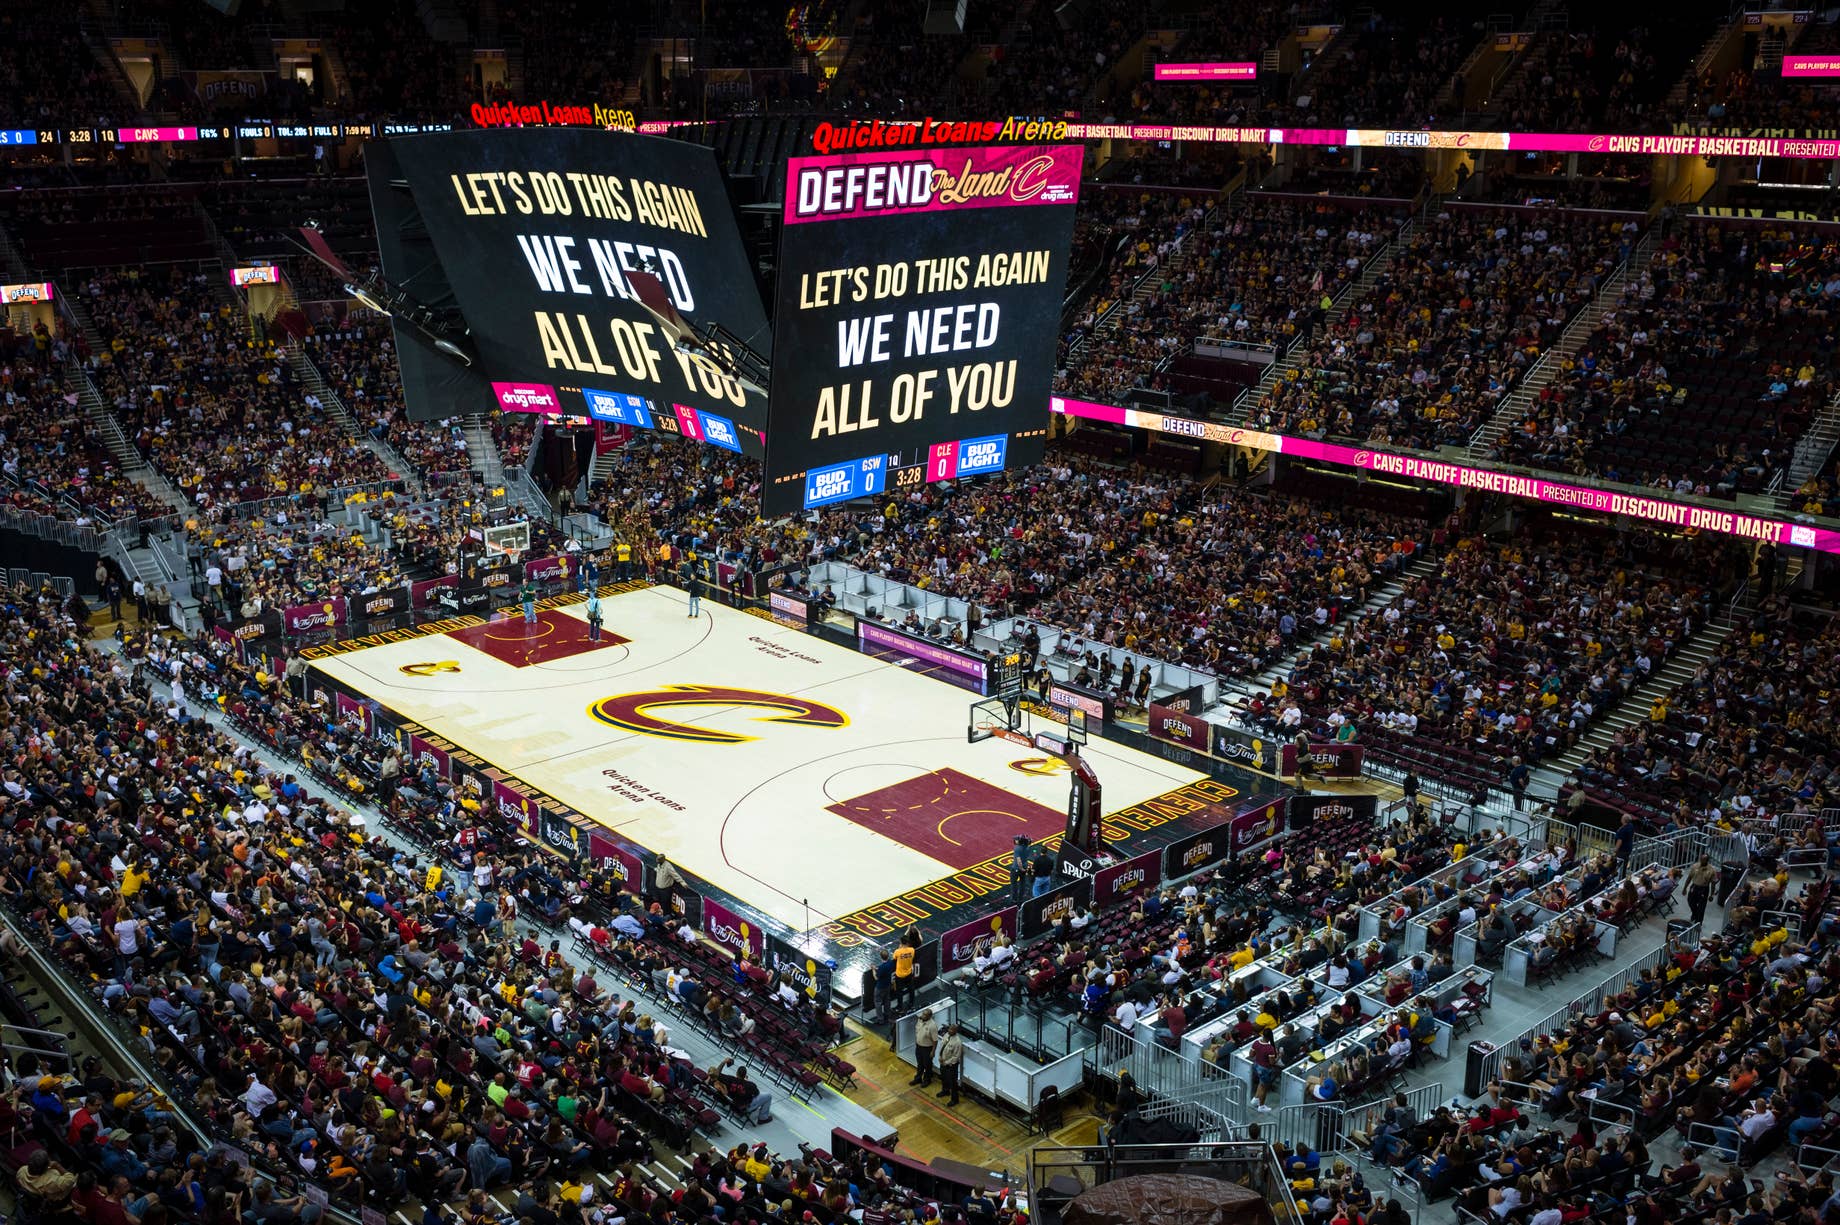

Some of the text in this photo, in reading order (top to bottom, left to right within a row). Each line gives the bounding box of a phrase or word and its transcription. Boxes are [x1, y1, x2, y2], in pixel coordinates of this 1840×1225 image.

[206, 81, 257, 100] DEFEND
[470, 101, 636, 129] Quicken Loans Arena
[16, 132, 22, 143] 0
[41, 132, 53, 143] 24
[70, 131, 91, 142] 3:28
[101, 130, 114, 142] 1Q
[135, 129, 159, 140] CAVS
[178, 129, 184, 140] 0
[200, 129, 218, 138] FG%
[223, 128, 229, 138] 0
[240, 128, 263, 138] FOULS
[264, 127, 270, 137] 0
[308, 127, 313, 136] 1
[314, 127, 332, 136] FULL
[332, 126, 338, 136] 6
[360, 126, 371, 135] PM
[812, 116, 1068, 154] Quicken Loans Arena
[1086, 125, 1132, 139] BASKETBALL
[1133, 127, 1162, 138] PRESENTED
[1163, 128, 1171, 138] BY
[1172, 127, 1214, 141] DISCOUNT
[1215, 128, 1238, 142] DRUG
[1240, 128, 1266, 142] MART
[1385, 132, 1430, 147] DEFEND
[1609, 136, 1641, 153] CAVS
[1642, 137, 1696, 155] PLAYOFF
[1698, 138, 1780, 157] BASKETBALL
[1783, 143, 1835, 157] PRESENTED
[797, 162, 934, 216] DEFEND
[939, 158, 1013, 204] Land
[451, 171, 708, 239] LET'S DO THIS AGAIN
[1040, 192, 1057, 202] drug
[516, 234, 592, 295] WE
[243, 271, 268, 283] DEFEND
[800, 250, 1050, 310] LET'S DO THIS AGAIN
[11, 288, 40, 300] DEFEND
[838, 302, 1001, 368] WE NEED
[535, 311, 617, 376] ALL
[610, 318, 661, 384] OF
[502, 391, 554, 408] drug mart
[594, 395, 616, 408] BUD
[810, 359, 1018, 440] ALL OF YOU
[594, 404, 625, 418] LIGHT
[635, 410, 644, 425] 0
[680, 406, 695, 419] CLE
[660, 415, 680, 432] 3:28
[687, 420, 696, 437] 0
[705, 418, 726, 433] BUD
[1163, 417, 1206, 437] DEFEND
[706, 428, 735, 446] LIGHT
[937, 444, 952, 456] CLE
[968, 442, 997, 457] BUD
[862, 457, 881, 472] GSW
[889, 455, 899, 467] 1Q
[938, 459, 947, 478] 0
[961, 452, 1002, 470] LIGHT
[816, 470, 847, 488] BUD
[865, 473, 874, 492] 0
[896, 468, 922, 486] 3:28
[809, 482, 850, 501] LIGHT
[1373, 454, 1784, 541] CAVS PLAYOFF BASKETBALL PRESENTED BY DISCOUNT DRUG MART
[482, 573, 510, 587] DEFEND
[366, 598, 394, 613] DEFEND
[235, 624, 265, 639] DEFEND
[299, 614, 487, 661] CLEVELAND
[748, 636, 822, 665] Quicken Loans
[756, 646, 787, 660] Arena
[314, 690, 330, 704] DEFEND
[1053, 691, 1080, 706] DEFEND
[1163, 718, 1192, 738] DEFEND
[421, 751, 440, 772] DEFEND
[462, 774, 483, 797] DEFEND
[602, 768, 688, 813] Quicken Loans
[607, 784, 645, 804] Arena
[1313, 806, 1354, 820] DEFEND
[1183, 842, 1213, 866] DEFEND
[604, 856, 629, 882] DEFEND
[1112, 868, 1145, 894] DEFEND
[1042, 897, 1074, 922] DEFEND
[716, 924, 755, 955] The Finals
[789, 962, 822, 992] Finals
